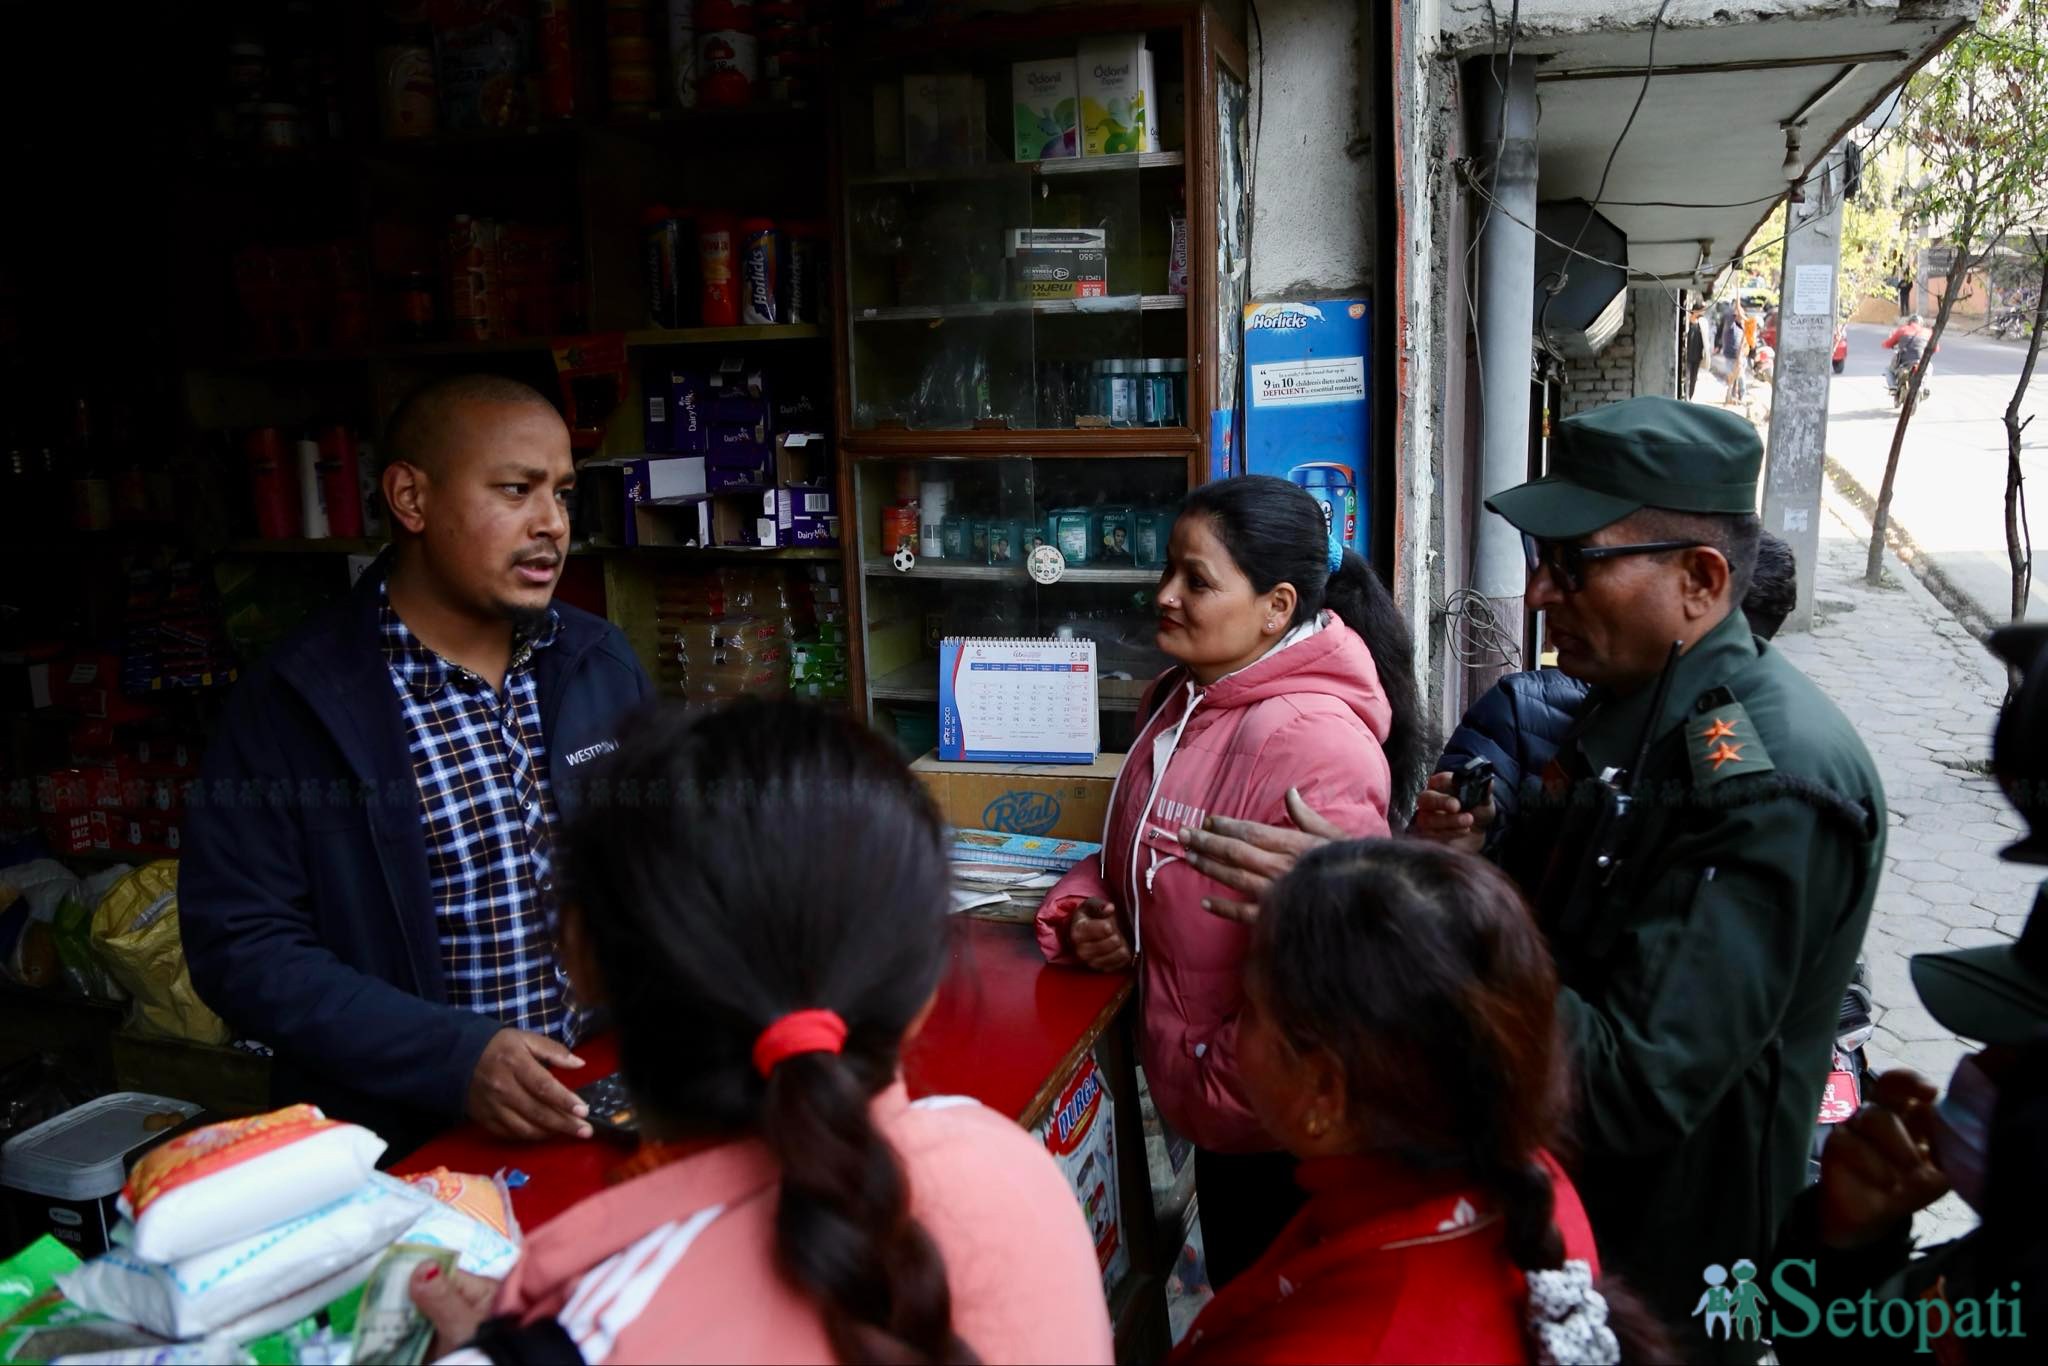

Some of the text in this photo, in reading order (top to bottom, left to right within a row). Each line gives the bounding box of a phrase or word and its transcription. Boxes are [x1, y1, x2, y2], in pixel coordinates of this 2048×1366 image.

[1094, 63, 1129, 79] Odonil
[752, 248, 768, 305] Horlicks
[1253, 312, 1308, 329] Horlicks
[1263, 380, 1271, 389] 9
[1282, 377, 1294, 388] 10
[1263, 387, 1305, 397] DEFICIENT
[688, 410, 698, 432] Dairy
[797, 530, 816, 542] Dairy
[1058, 1071, 1100, 1141] DURGA
